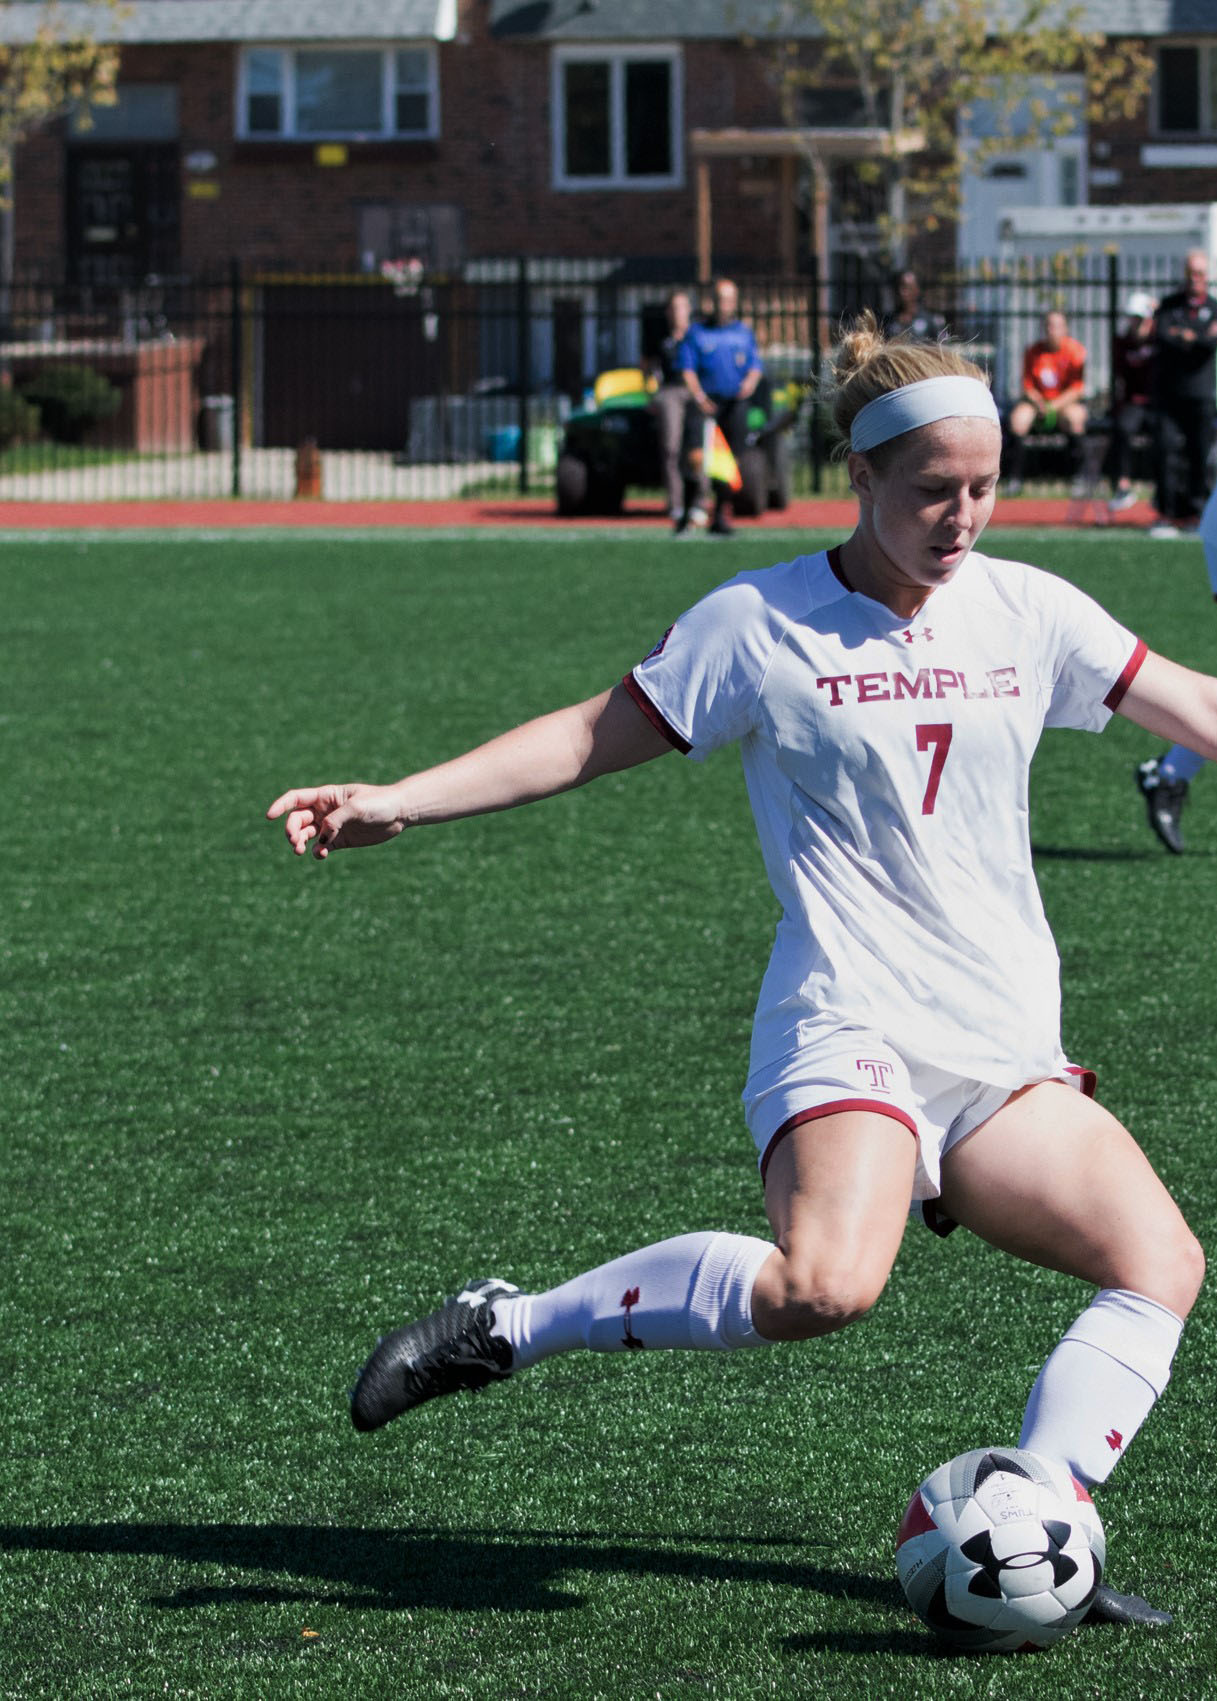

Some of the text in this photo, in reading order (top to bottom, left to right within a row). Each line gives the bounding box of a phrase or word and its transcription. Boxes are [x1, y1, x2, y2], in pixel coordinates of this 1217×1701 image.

[816, 667, 1020, 706] TEMPLE
[915, 723, 953, 815] 7
[856, 1060, 894, 1094] T
